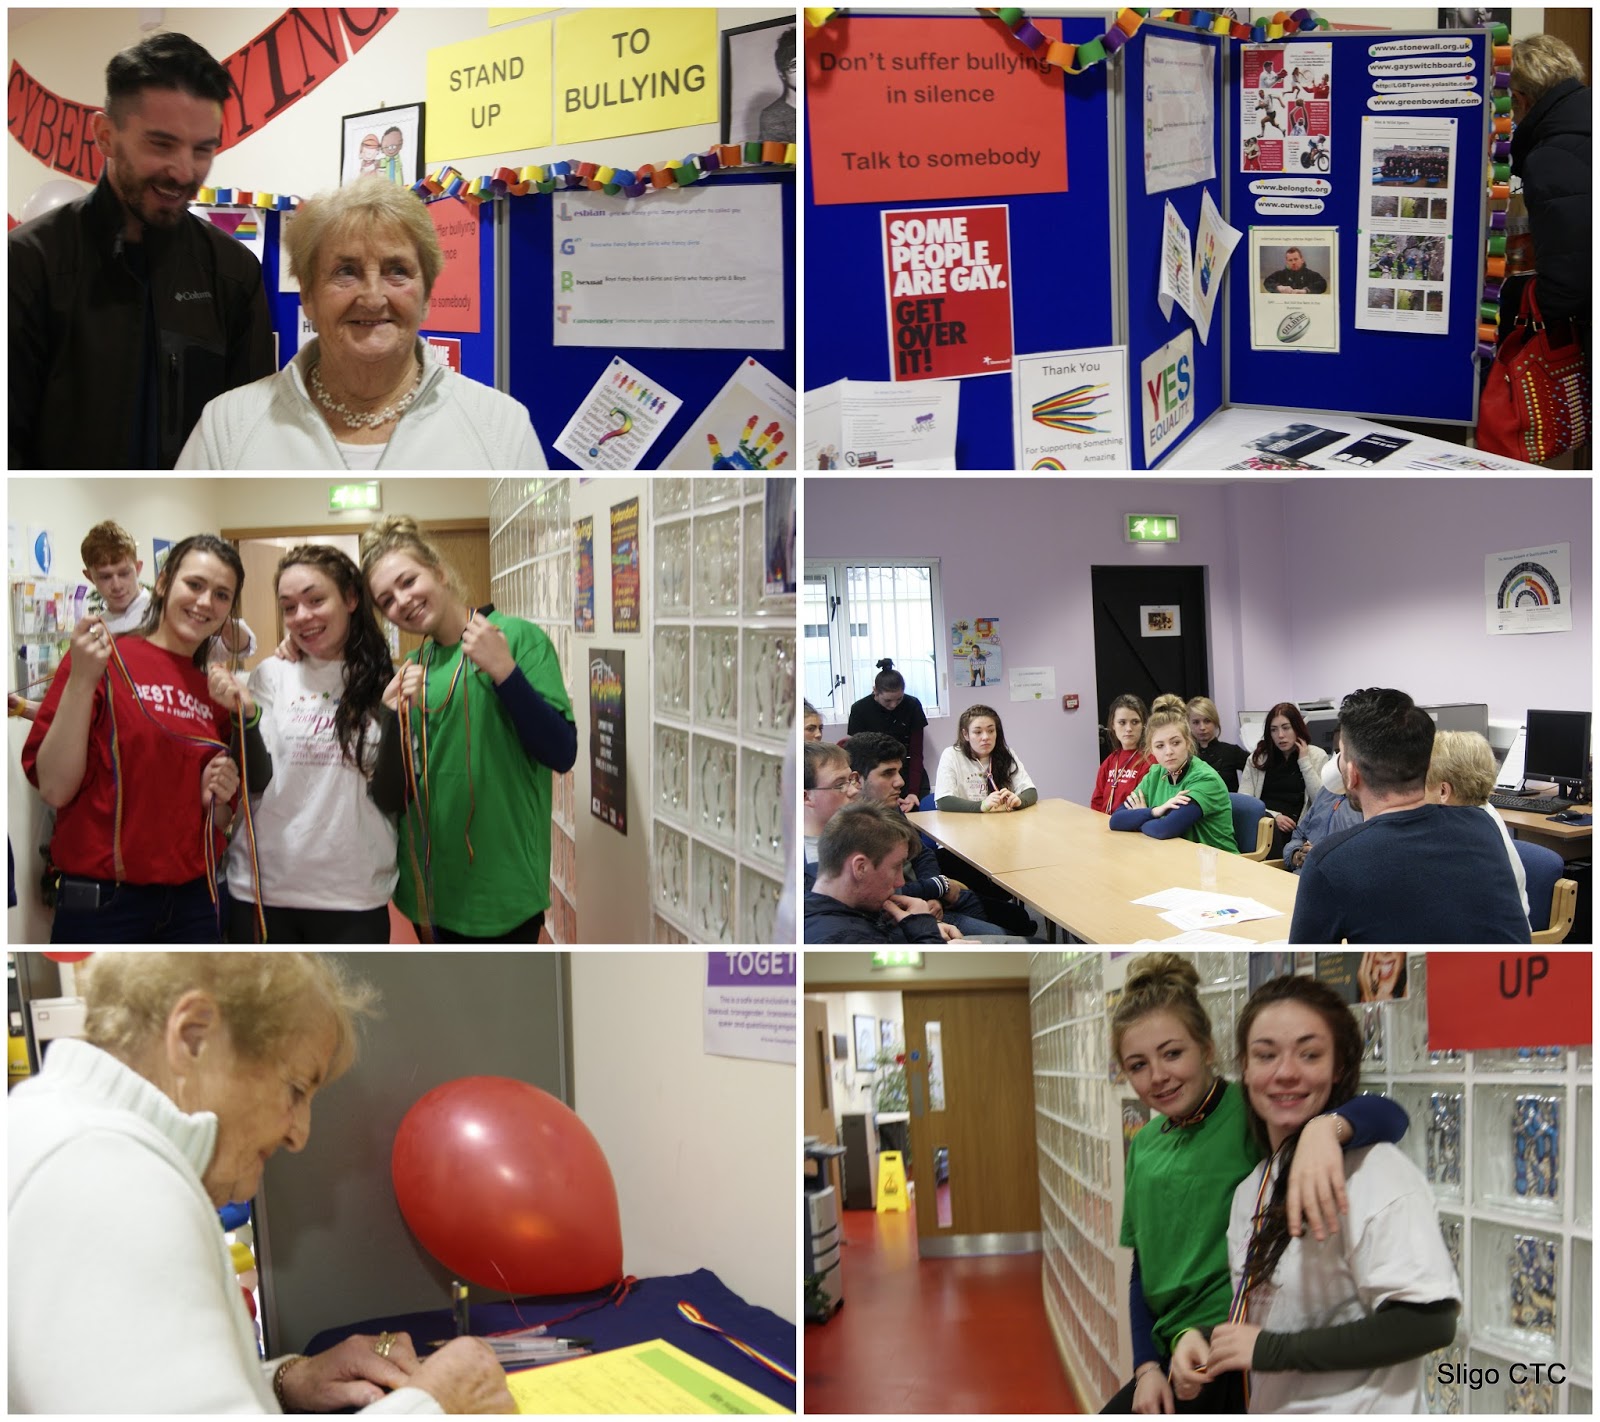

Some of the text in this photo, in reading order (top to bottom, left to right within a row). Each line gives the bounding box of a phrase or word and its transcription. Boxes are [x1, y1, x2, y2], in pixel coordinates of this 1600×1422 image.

[612, 27, 650, 58] TO
[1374, 43, 1470, 51] www.stonewall.org.uk
[450, 56, 524, 92] STAND
[820, 52, 1052, 75] Don't suffer bullying
[1370, 62, 1472, 71] www.gayswitchboard.ie
[565, 64, 705, 113] BULLYING
[886, 85, 995, 103] in silence
[1373, 98, 1479, 106] www.greenbowdeaf.com
[471, 103, 501, 129] UP
[841, 147, 1041, 170] Talk to somebody
[1256, 184, 1329, 194] www.belongto.org
[1258, 201, 1322, 210] www.outwest.ie
[449, 220, 476, 238] bullying
[890, 216, 968, 247] SOME
[892, 241, 989, 271] PEOPLE
[893, 264, 1007, 297] ARE GAY.
[438, 294, 471, 311] somebody
[896, 298, 945, 326] GET
[897, 321, 967, 350] OVER
[899, 349, 932, 375] IT!
[1042, 362, 1101, 376] Thank You
[1147, 354, 1190, 422] YES
[1149, 402, 1190, 448] EQUALITY
[1025, 437, 1123, 455] For Supporting Something
[1083, 453, 1116, 463] Amazing
[1499, 954, 1549, 999] UP
